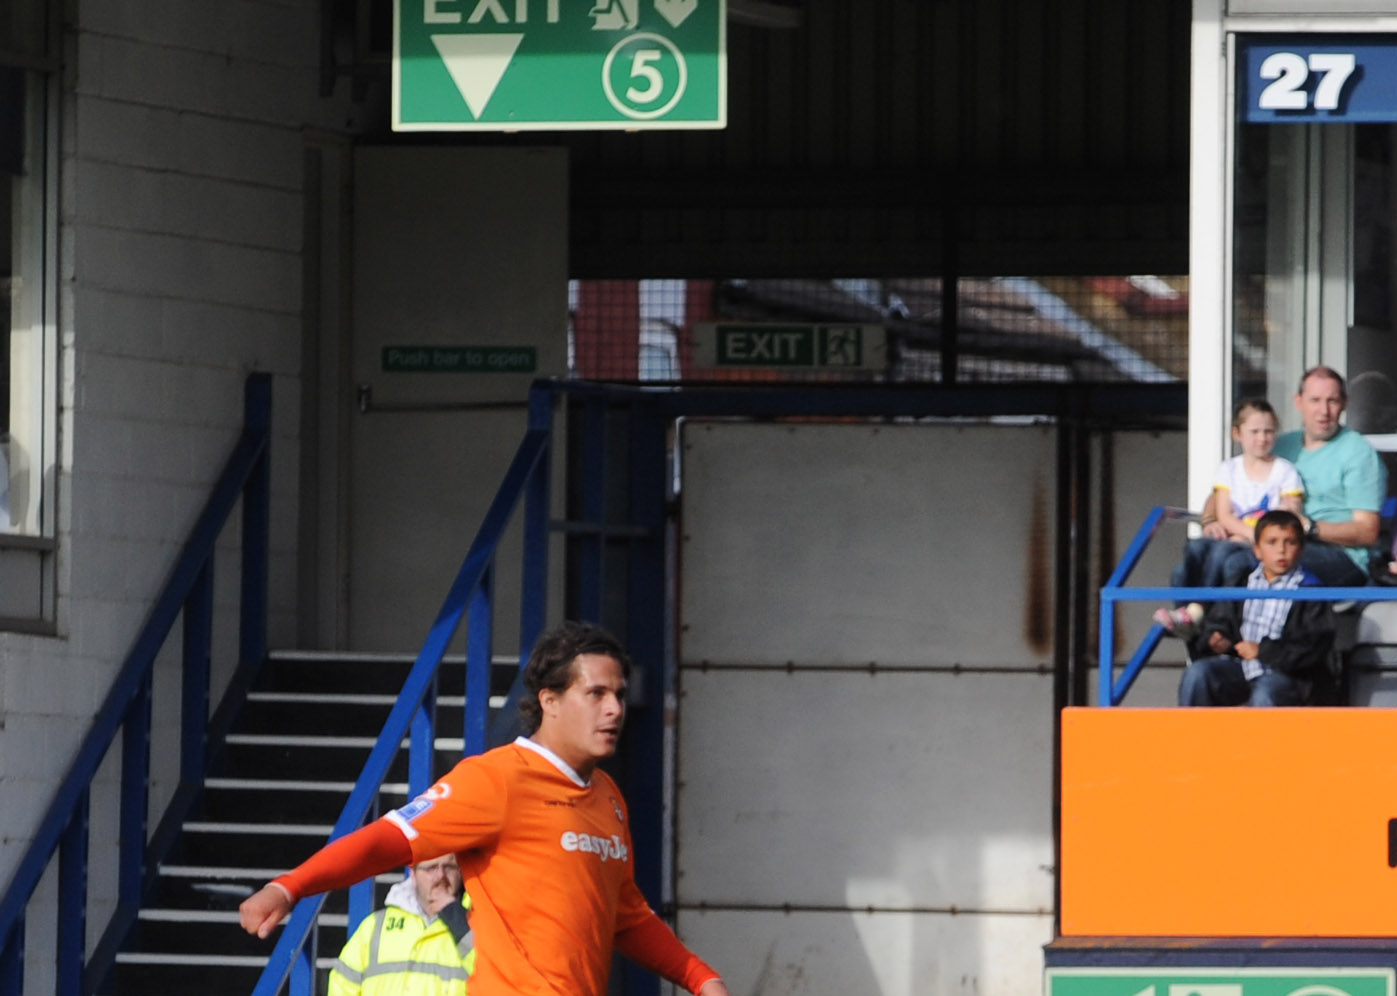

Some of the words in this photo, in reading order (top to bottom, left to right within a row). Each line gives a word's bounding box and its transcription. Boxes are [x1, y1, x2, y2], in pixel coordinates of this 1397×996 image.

[625, 50, 664, 104] 5
[1258, 52, 1356, 110] 27
[725, 332, 803, 359] EXIT
[387, 349, 430, 366] Push
[433, 349, 461, 366] bar
[465, 351, 483, 367] to
[487, 351, 531, 370] open
[386, 917, 405, 931] 34
